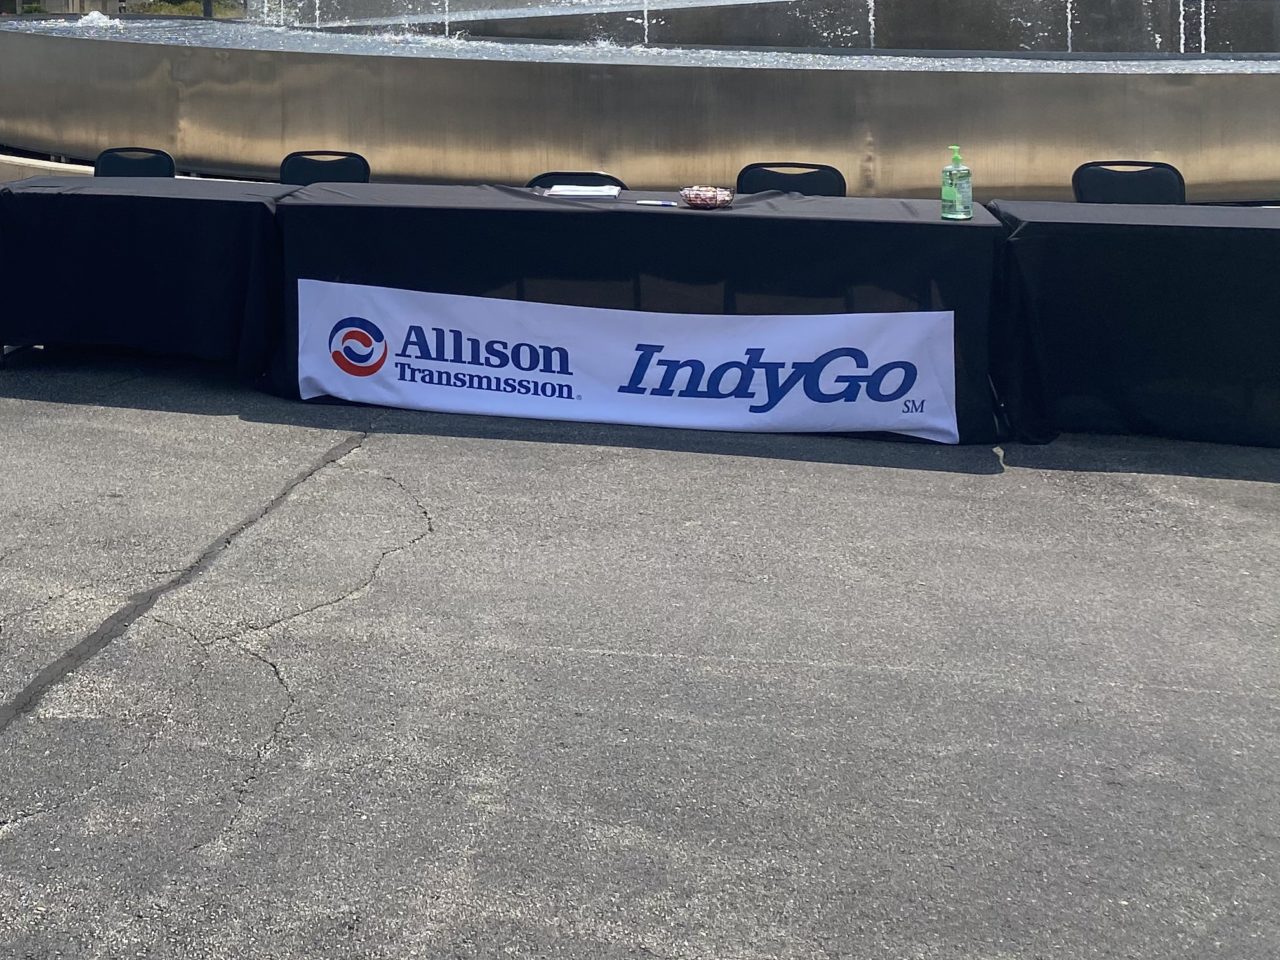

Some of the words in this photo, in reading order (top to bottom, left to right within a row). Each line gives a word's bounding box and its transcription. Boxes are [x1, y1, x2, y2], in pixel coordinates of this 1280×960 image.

[395, 325, 573, 376] Allison
[395, 362, 575, 400] Transmission
[618, 343, 918, 414] IndyGo
[902, 400, 925, 414] SM
